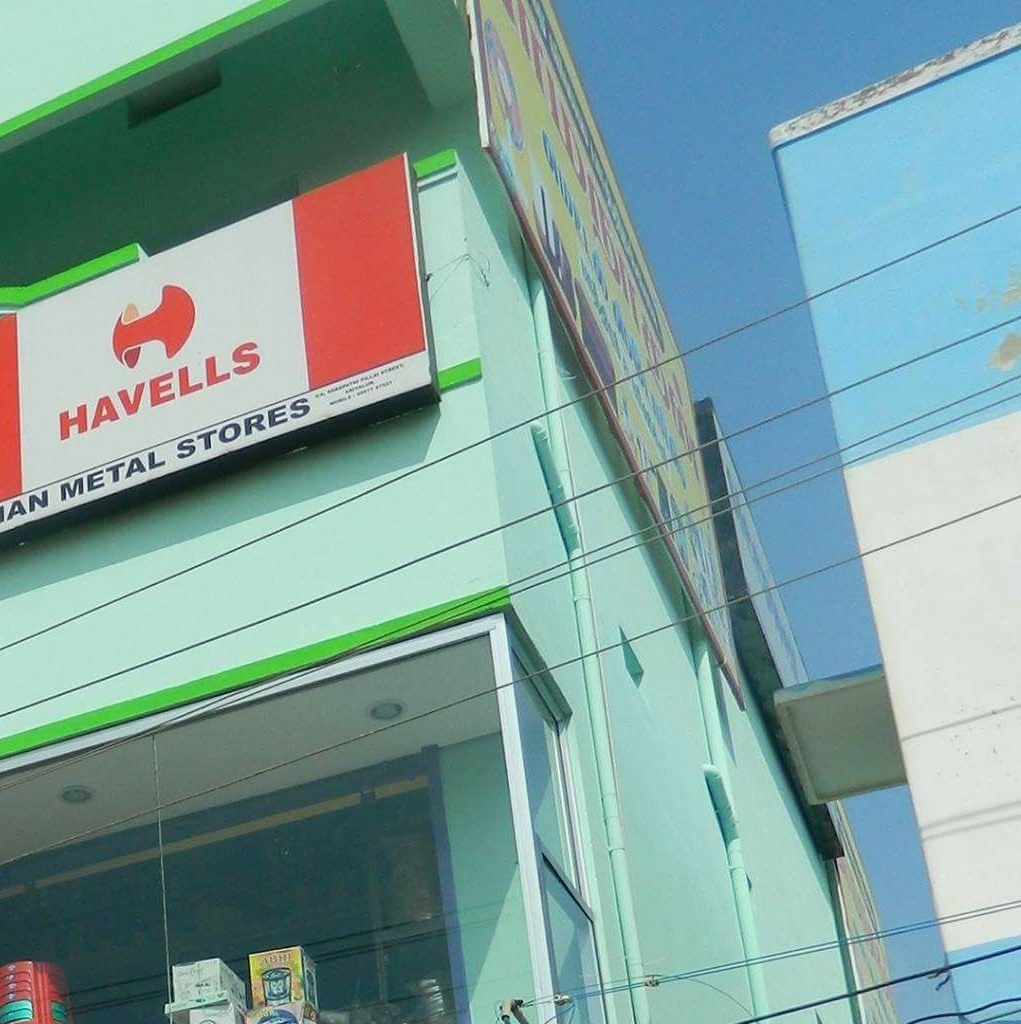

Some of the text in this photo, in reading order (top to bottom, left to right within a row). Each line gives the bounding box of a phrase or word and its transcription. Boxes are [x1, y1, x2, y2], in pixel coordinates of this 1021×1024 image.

[61, 342, 260, 440] HAVELLS
[61, 454, 165, 502] METAL
[177, 398, 311, 458] STORES
